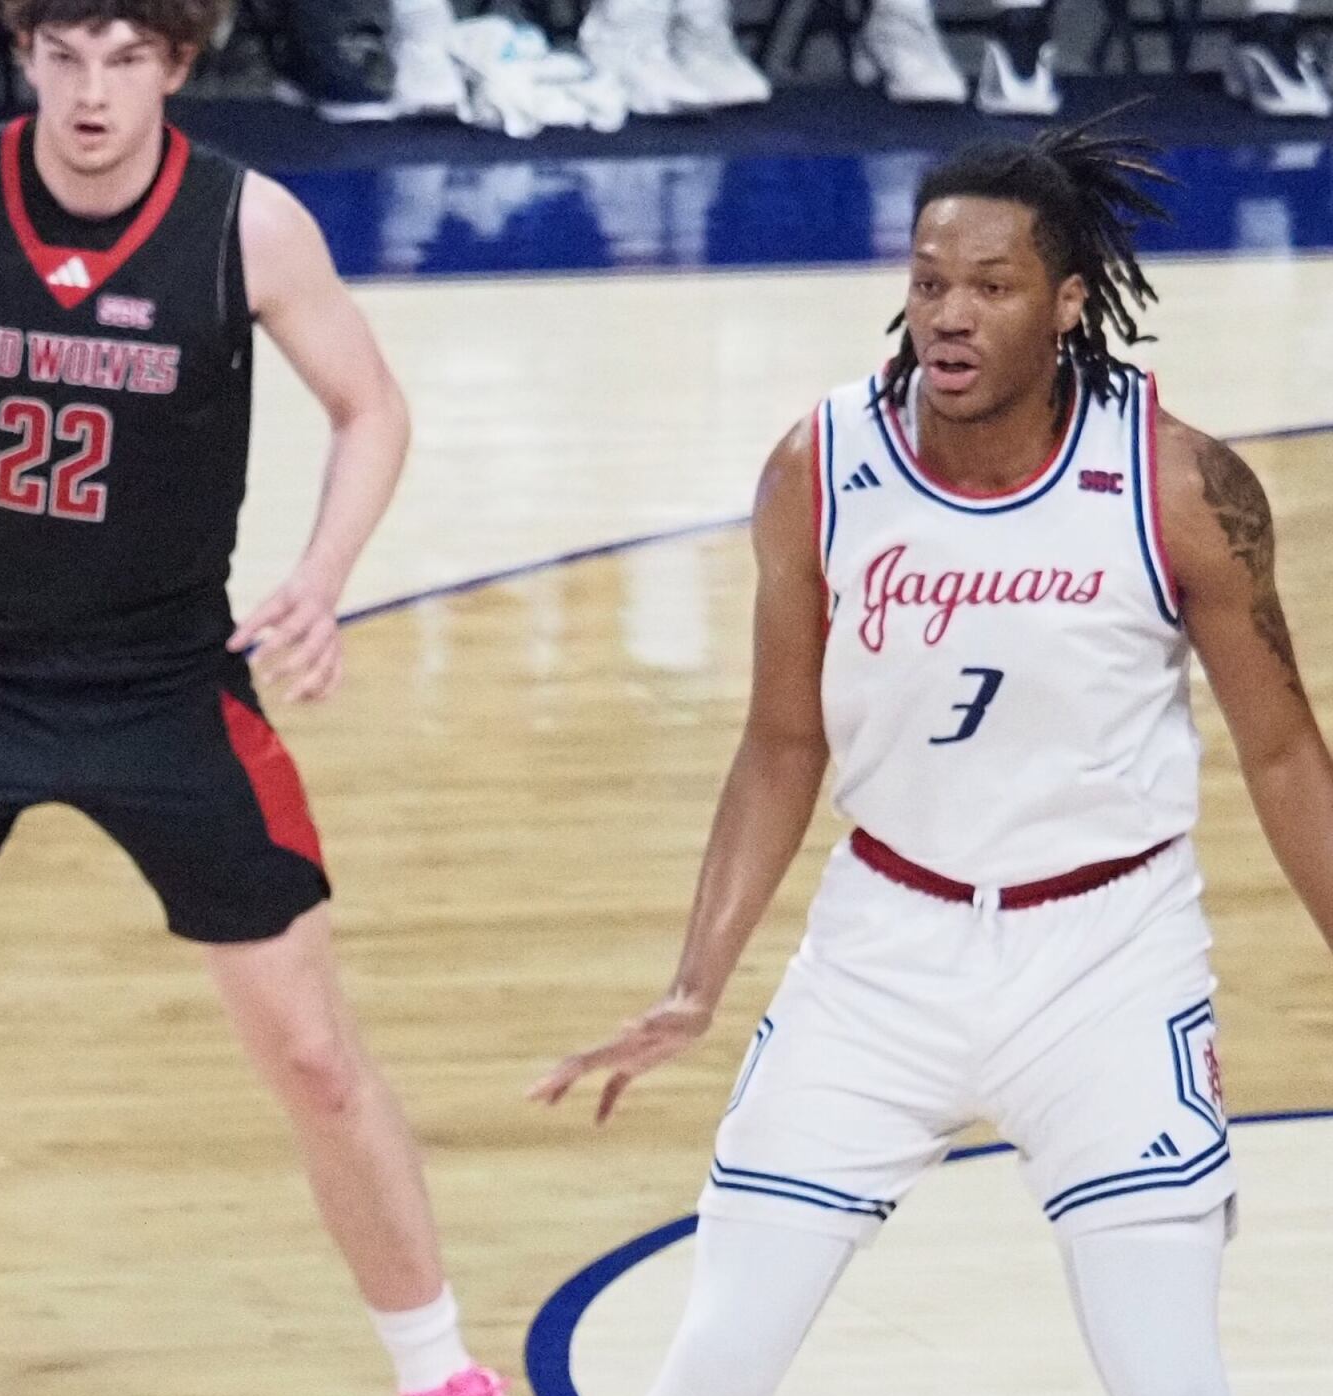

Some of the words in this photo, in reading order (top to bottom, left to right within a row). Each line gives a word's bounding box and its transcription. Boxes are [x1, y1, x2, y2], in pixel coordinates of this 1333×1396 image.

[26, 329, 181, 394] WOLVES
[858, 544, 1105, 655] Jaguars
[928, 666, 1004, 744] 3
